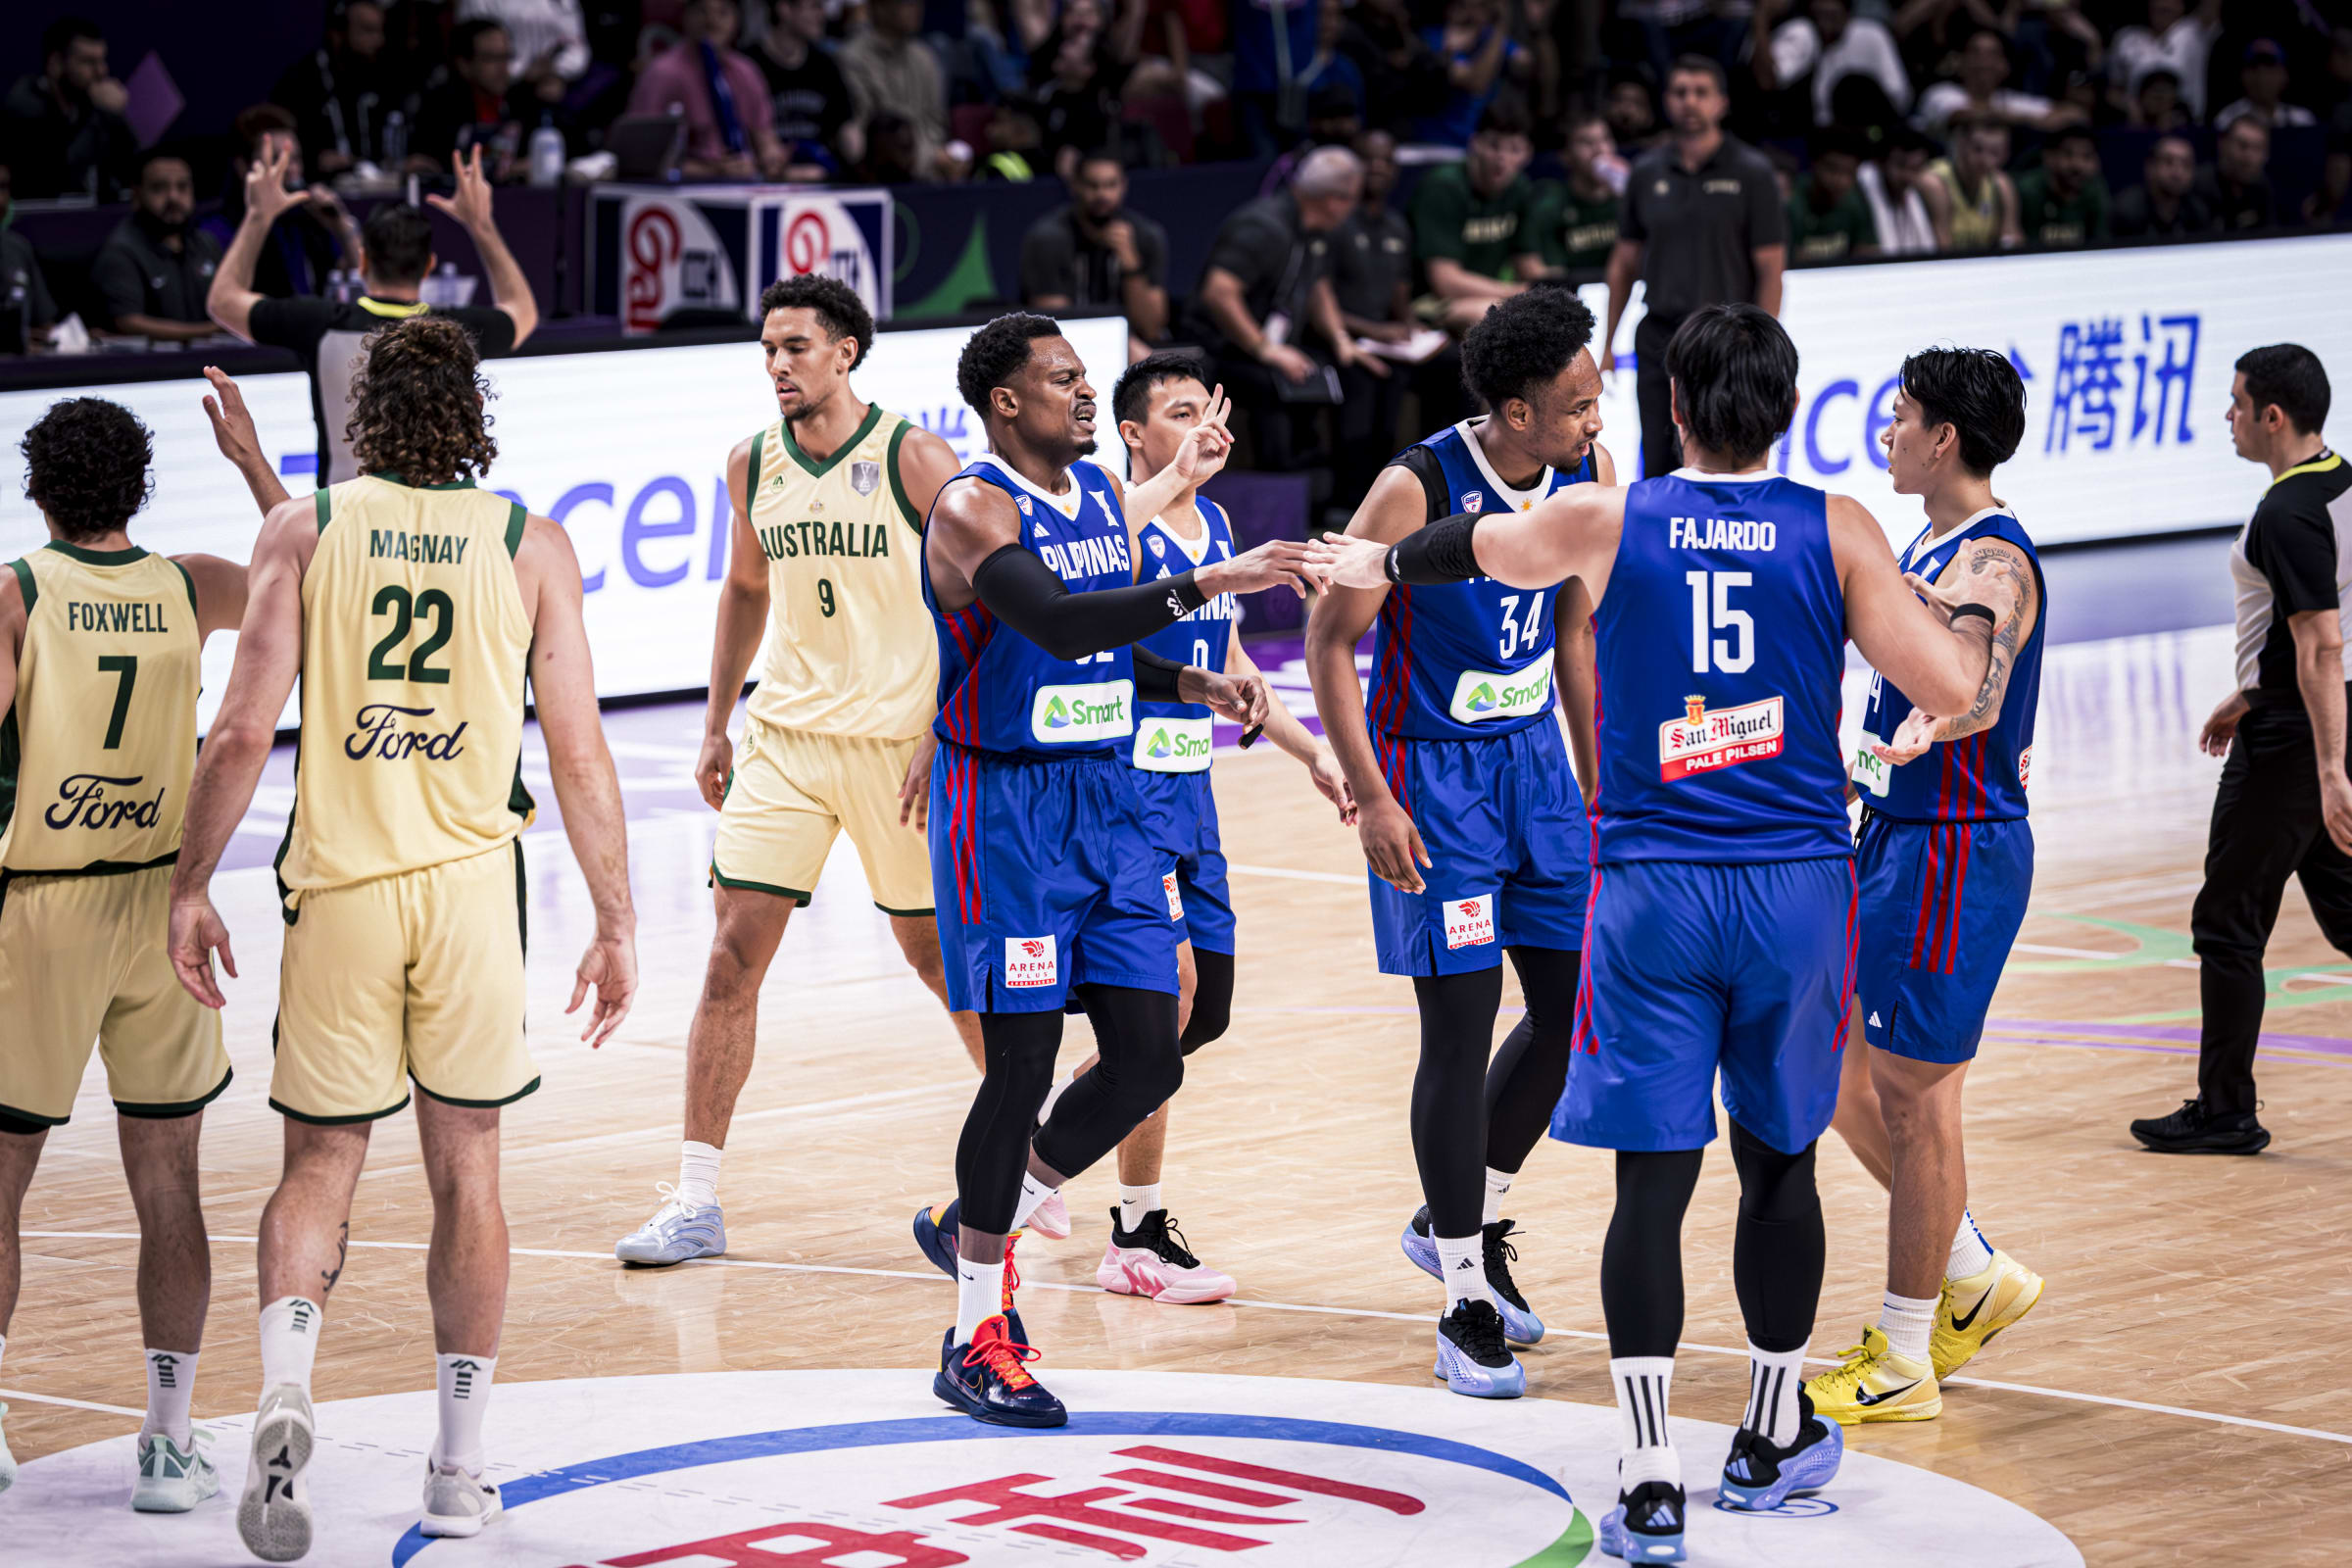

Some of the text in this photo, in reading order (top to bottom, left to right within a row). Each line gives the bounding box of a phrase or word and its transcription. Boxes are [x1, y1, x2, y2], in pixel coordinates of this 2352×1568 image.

[2044, 314, 2201, 455] 腾讯
[369, 529, 468, 565] MAGNAY
[760, 521, 889, 562] AUSTRALIA
[1669, 516, 1777, 552] FAJARDO
[68, 602, 169, 634] FOXWELL
[817, 578, 836, 618] 9
[368, 585, 455, 684] 22
[1499, 591, 1544, 660] 34
[1686, 570, 1755, 673] 15
[97, 655, 138, 751] 7
[1498, 667, 1549, 709] Smart
[1071, 696, 1124, 725] Smart
[1670, 710, 1773, 750] San Miguel
[344, 704, 468, 761] Ford
[1173, 733, 1210, 758] Sma
[1686, 740, 1777, 771] PALE PILSEN
[44, 773, 166, 831] Ford
[1449, 919, 1491, 934] ARENA
[1009, 960, 1054, 971] ARENA
